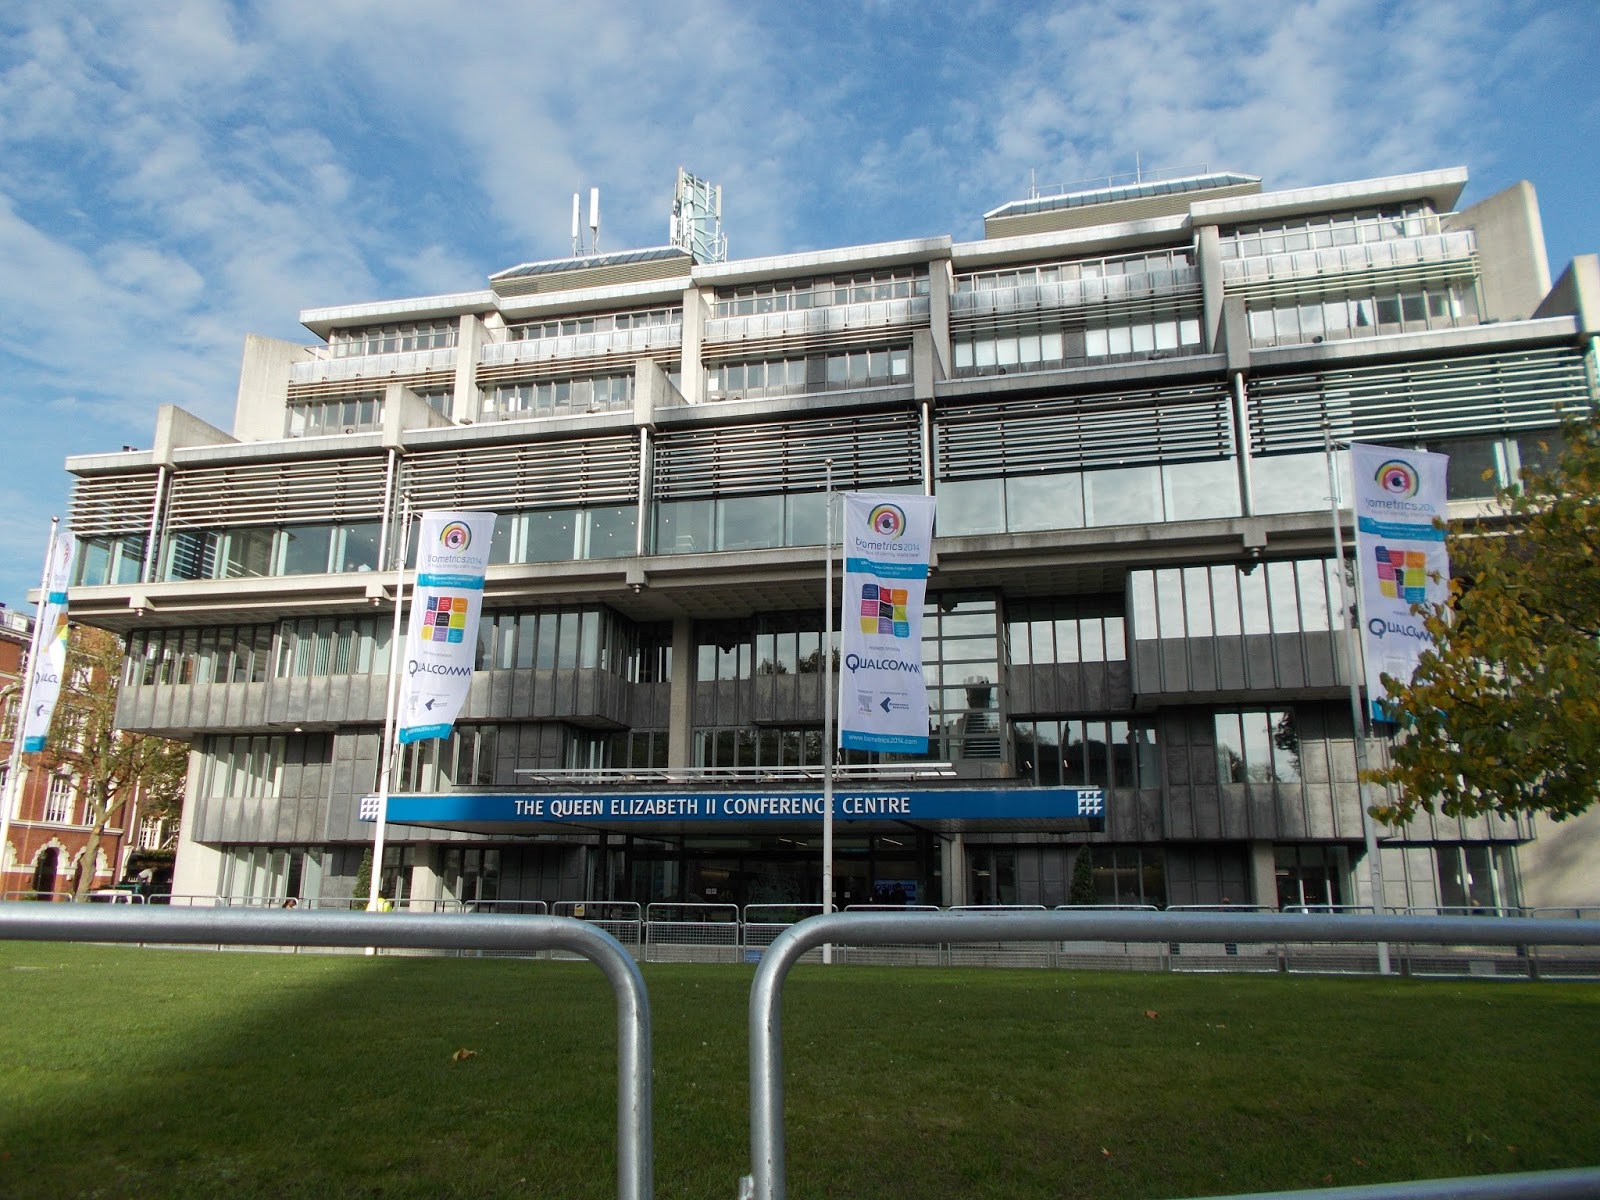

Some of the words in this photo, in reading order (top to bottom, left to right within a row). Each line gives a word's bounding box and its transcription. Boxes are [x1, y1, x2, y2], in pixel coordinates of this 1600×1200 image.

[408, 659, 472, 677] QUALCOMM
[845, 653, 920, 674] QUALCOMM
[514, 800, 544, 815] THE
[550, 800, 603, 817] QUEEN
[610, 799, 698, 815] ELIZABETH
[706, 798, 716, 814] II
[723, 798, 835, 815] CONFERENC
[842, 797, 911, 814] CENTRE
